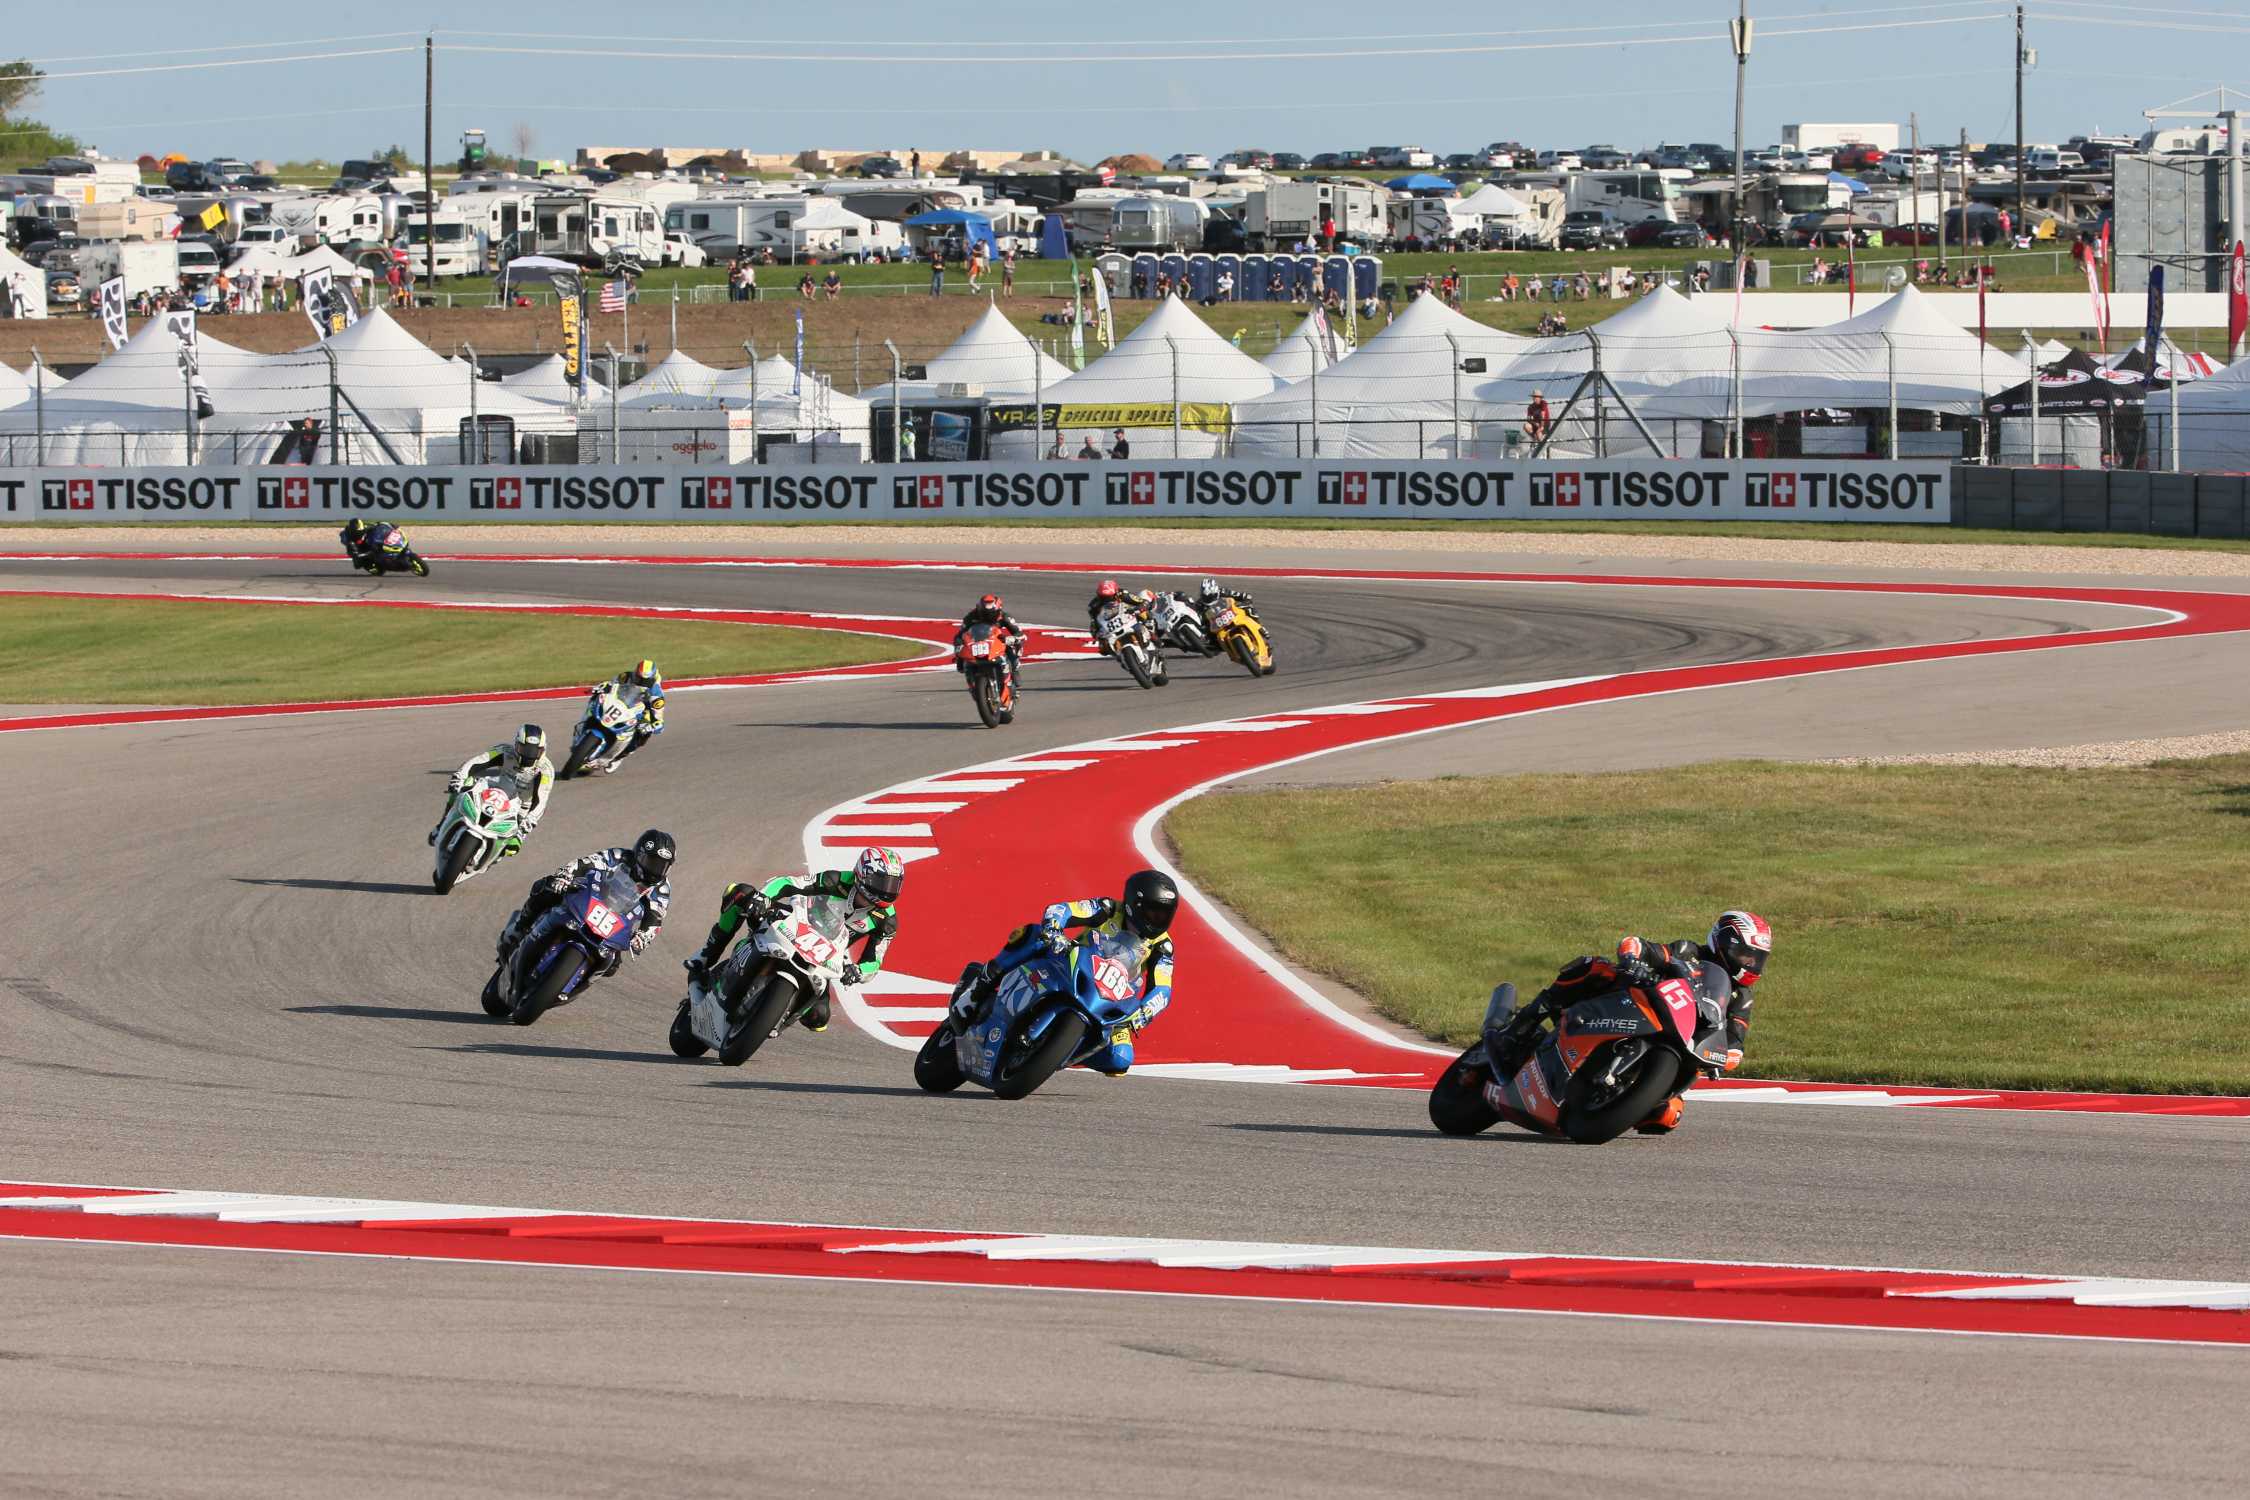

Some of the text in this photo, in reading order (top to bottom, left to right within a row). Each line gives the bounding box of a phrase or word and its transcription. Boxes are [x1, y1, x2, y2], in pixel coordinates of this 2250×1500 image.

[561, 296, 578, 375] GALFER
[1063, 408, 1176, 423] OFFICIAL APPARE
[98, 477, 241, 511] TISSOT
[313, 476, 453, 510] TISSOT
[526, 476, 665, 510] TISSOT
[736, 475, 878, 510] TISSOT
[947, 472, 1090, 508] TISSOT
[1158, 470, 1302, 506] TISSOT
[1371, 471, 1514, 507] TISSOT
[1584, 471, 1730, 508] TISSOT
[1800, 472, 1942, 510] TISSOT
[1659, 980, 1691, 1010] 15
[1586, 1017, 1639, 1031] HAYES
